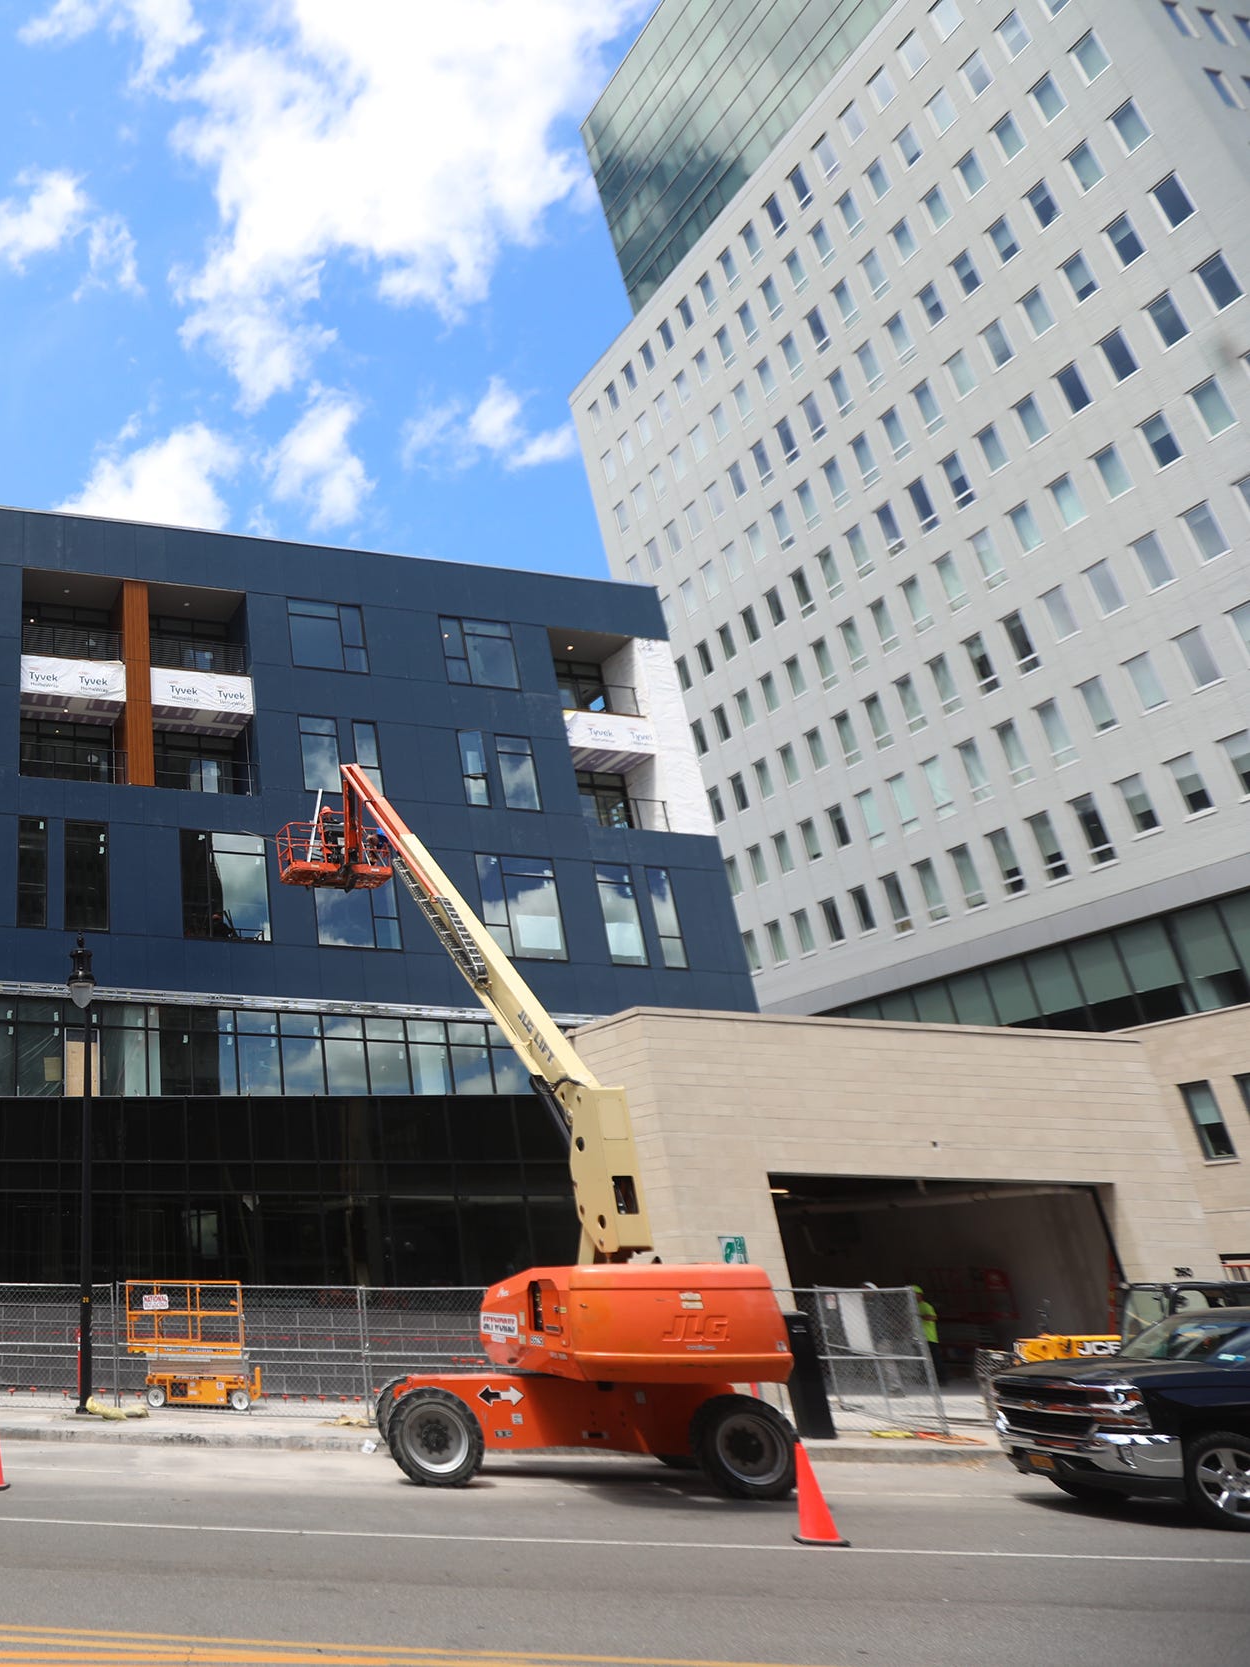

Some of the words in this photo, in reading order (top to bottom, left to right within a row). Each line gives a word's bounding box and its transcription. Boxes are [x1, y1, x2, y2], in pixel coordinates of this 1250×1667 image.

[29, 671, 58, 682] Tyvek
[78, 675, 108, 686] Tyvek
[170, 685, 198, 695] Tyvek
[217, 690, 245, 701] Tyvek
[588, 727, 614, 737] Tyvek
[662, 1315, 729, 1342] JLG
